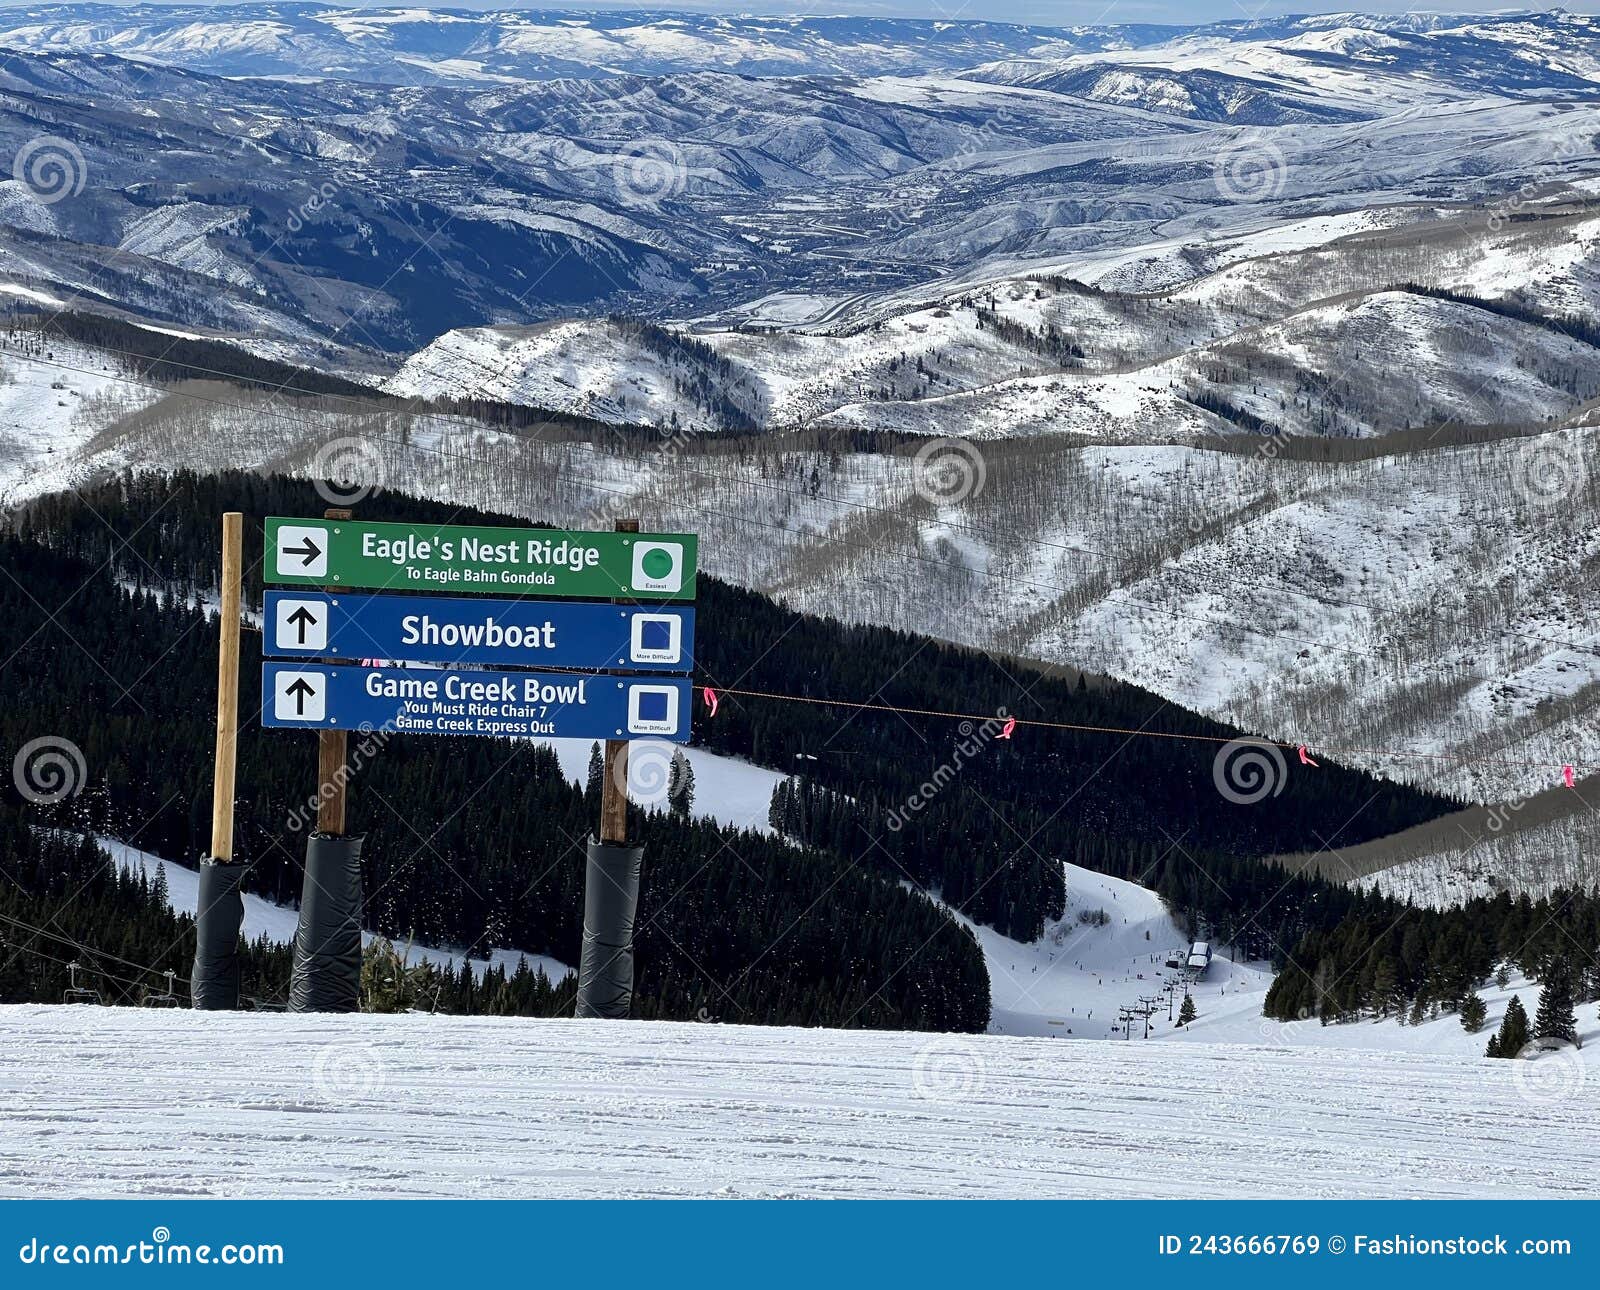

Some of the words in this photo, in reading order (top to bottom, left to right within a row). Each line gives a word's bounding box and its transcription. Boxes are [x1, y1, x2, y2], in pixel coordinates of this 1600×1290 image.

[362, 533, 454, 565] Eagle's
[461, 538, 520, 563] Nest
[527, 540, 600, 572] Ridge
[405, 566, 421, 579] To
[424, 567, 460, 584] Eagle
[464, 569, 498, 583] Bahn
[501, 570, 556, 585] Gondola
[402, 615, 556, 648] Showboat
[366, 672, 438, 699] Game
[445, 675, 517, 702] Creek
[524, 678, 587, 704] Bowl
[404, 700, 428, 713] You
[432, 701, 465, 715] Must
[468, 703, 498, 717] Ride
[501, 704, 536, 718] Chair
[539, 706, 547, 718] 7
[396, 715, 434, 729] Game
[436, 717, 474, 731] Creek
[477, 718, 527, 734] Express
[530, 720, 555, 734] Out
